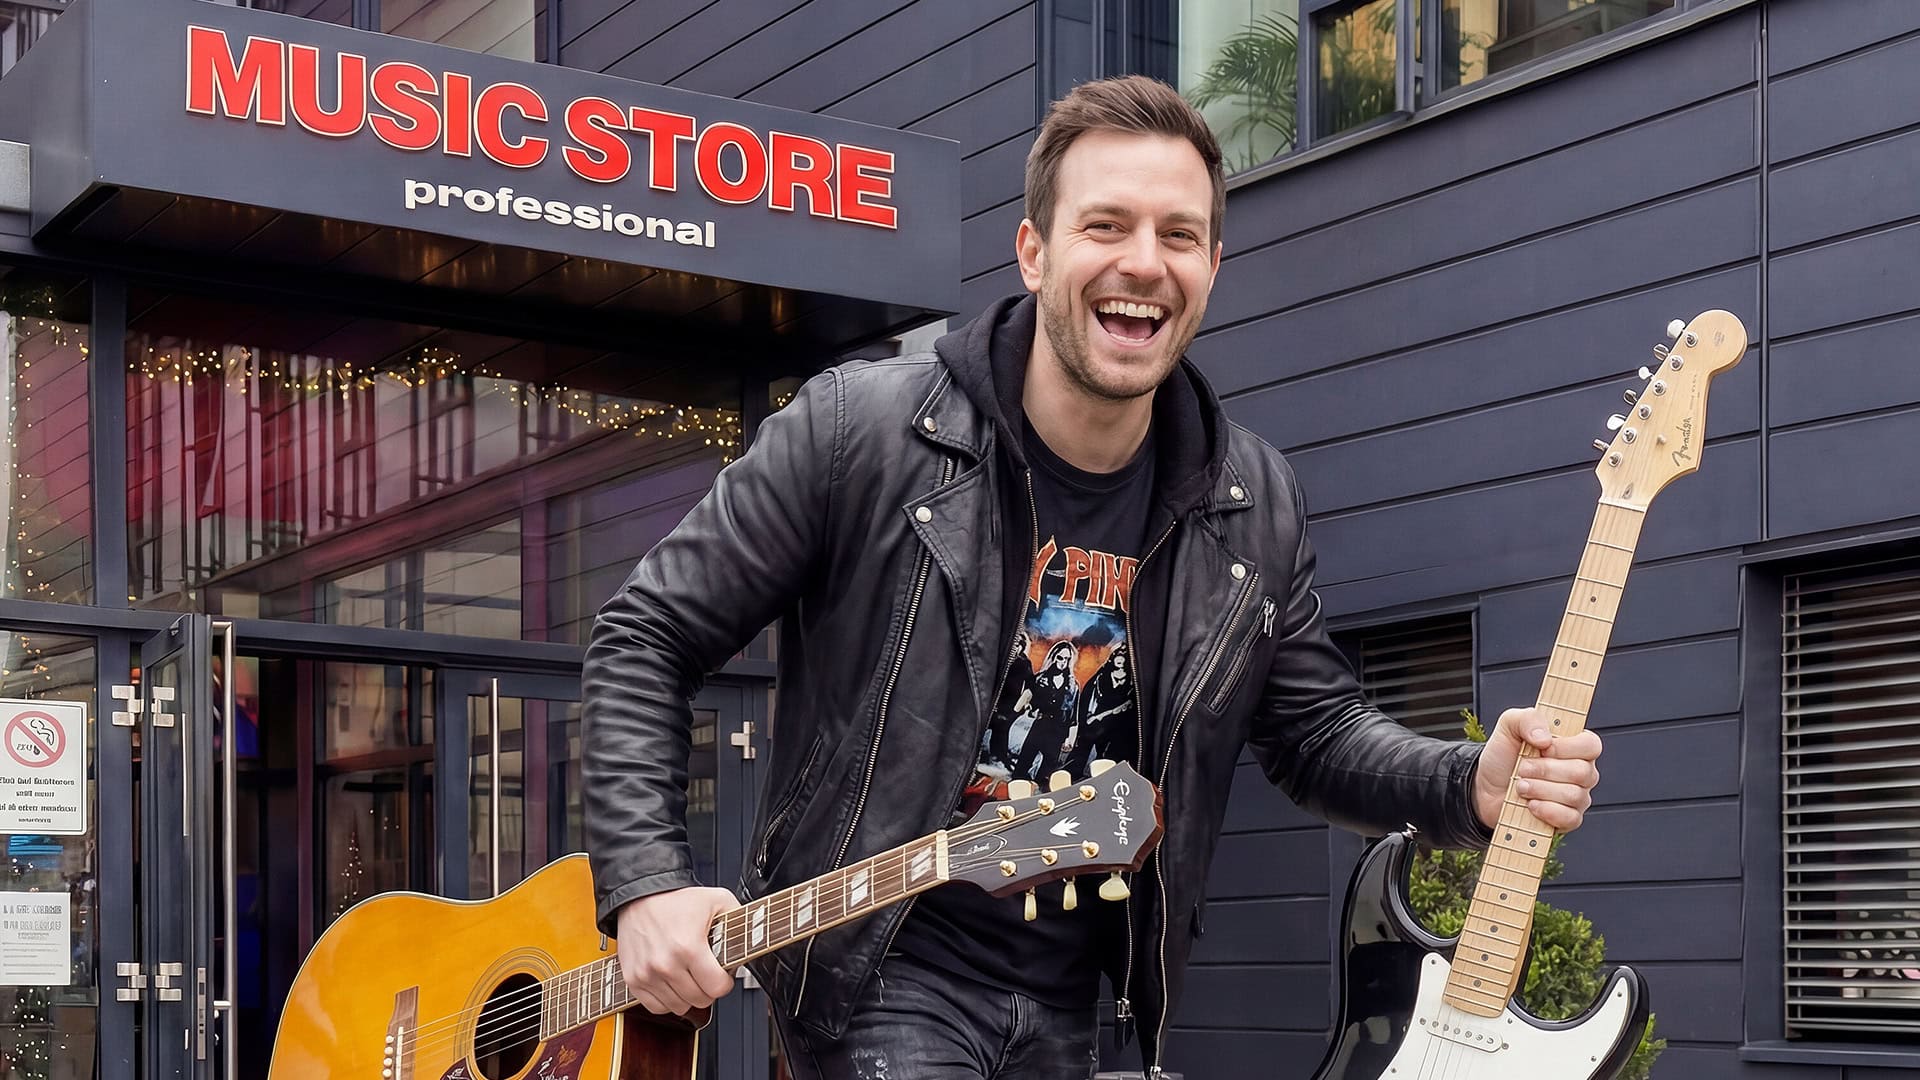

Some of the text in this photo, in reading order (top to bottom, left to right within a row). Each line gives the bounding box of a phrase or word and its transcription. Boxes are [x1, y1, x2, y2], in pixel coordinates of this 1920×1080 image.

[185, 24, 897, 230] MUSIC STORE
[404, 179, 716, 249] professional
